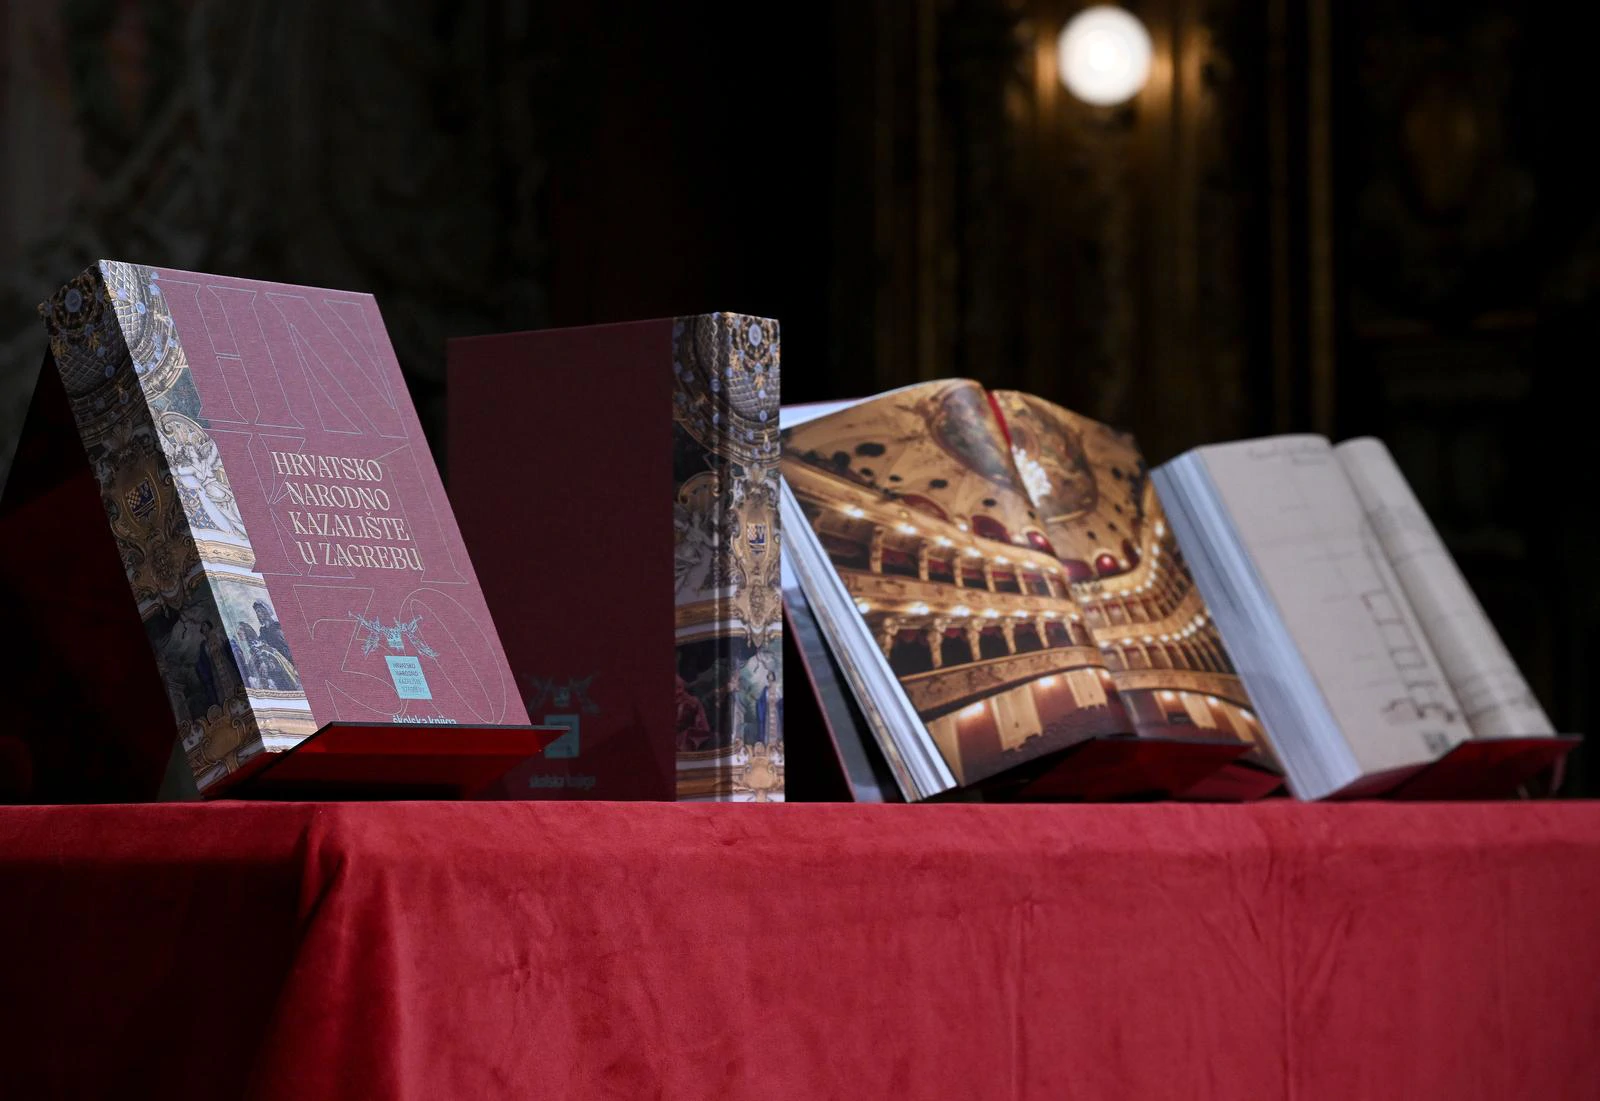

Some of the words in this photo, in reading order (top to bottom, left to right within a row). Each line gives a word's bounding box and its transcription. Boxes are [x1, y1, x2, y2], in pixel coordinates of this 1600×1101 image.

[271, 451, 383, 482] HRVATSKO
[285, 481, 390, 511] NARODNO
[288, 510, 410, 541] KAZALIŠTE
[296, 541, 318, 565] U
[319, 542, 425, 572] ZAGREBU
